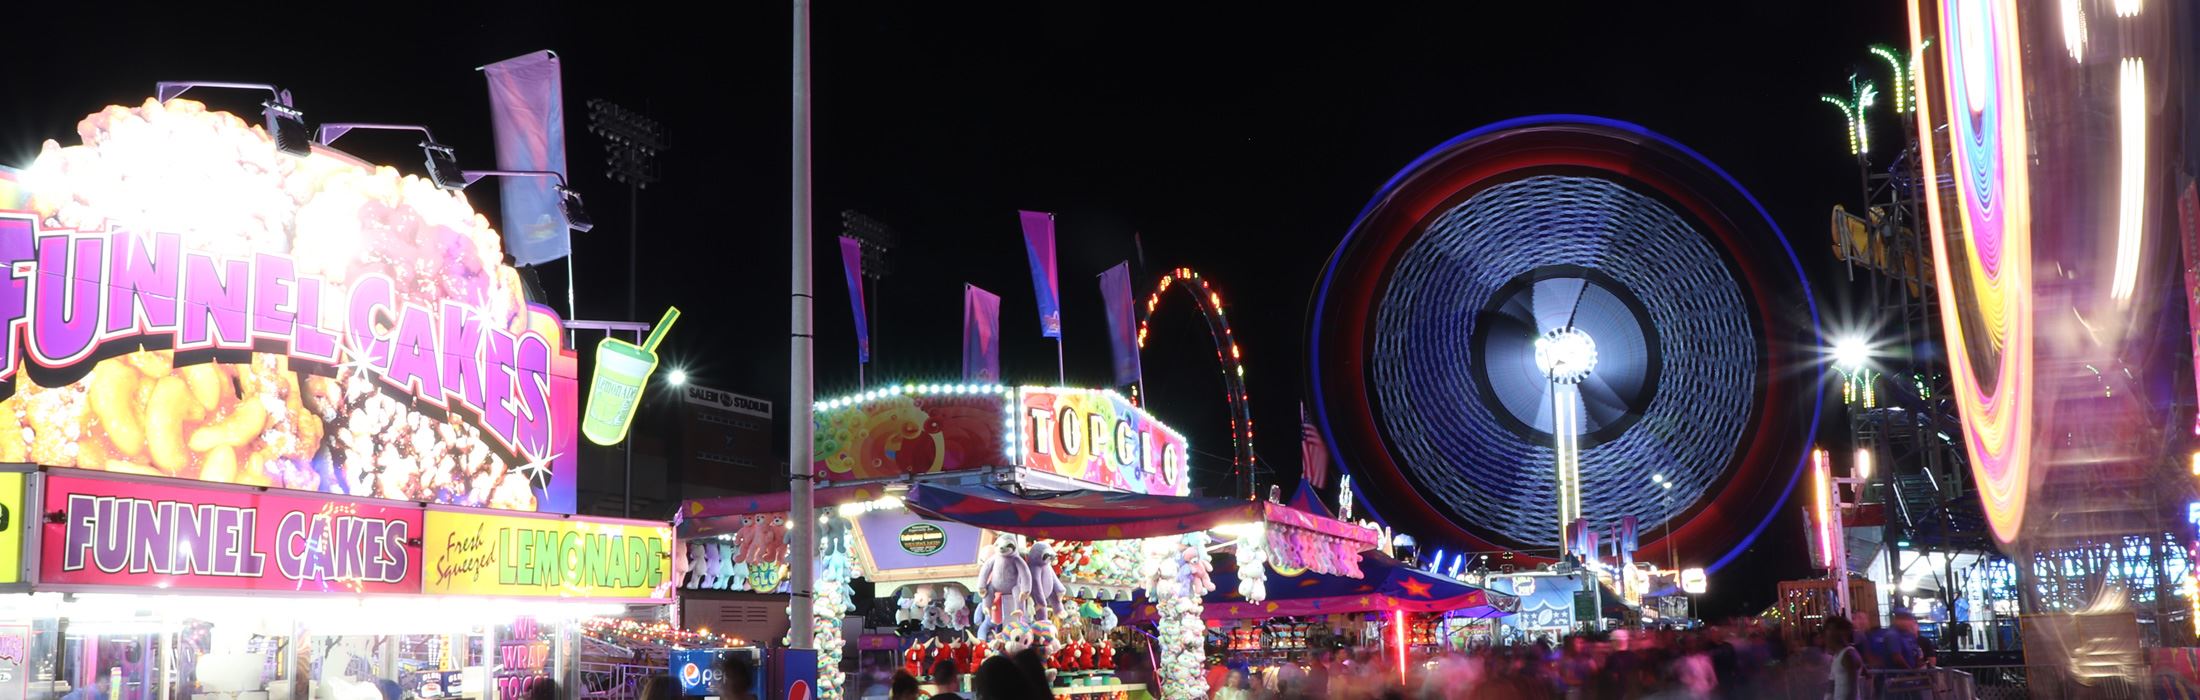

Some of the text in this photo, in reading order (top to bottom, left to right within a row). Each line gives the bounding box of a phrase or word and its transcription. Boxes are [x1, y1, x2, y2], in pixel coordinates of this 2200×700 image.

[0, 212, 553, 466] FUNNEL CAKES
[688, 386, 770, 414] SALEM STADIUM
[63, 493, 409, 583] FUNNEL CAKES
[446, 522, 484, 561] Fresh
[498, 527, 664, 590] LEMONADE
[435, 540, 496, 590] Squeezed
[513, 615, 538, 641] WE
[500, 643, 549, 671] WRAP
